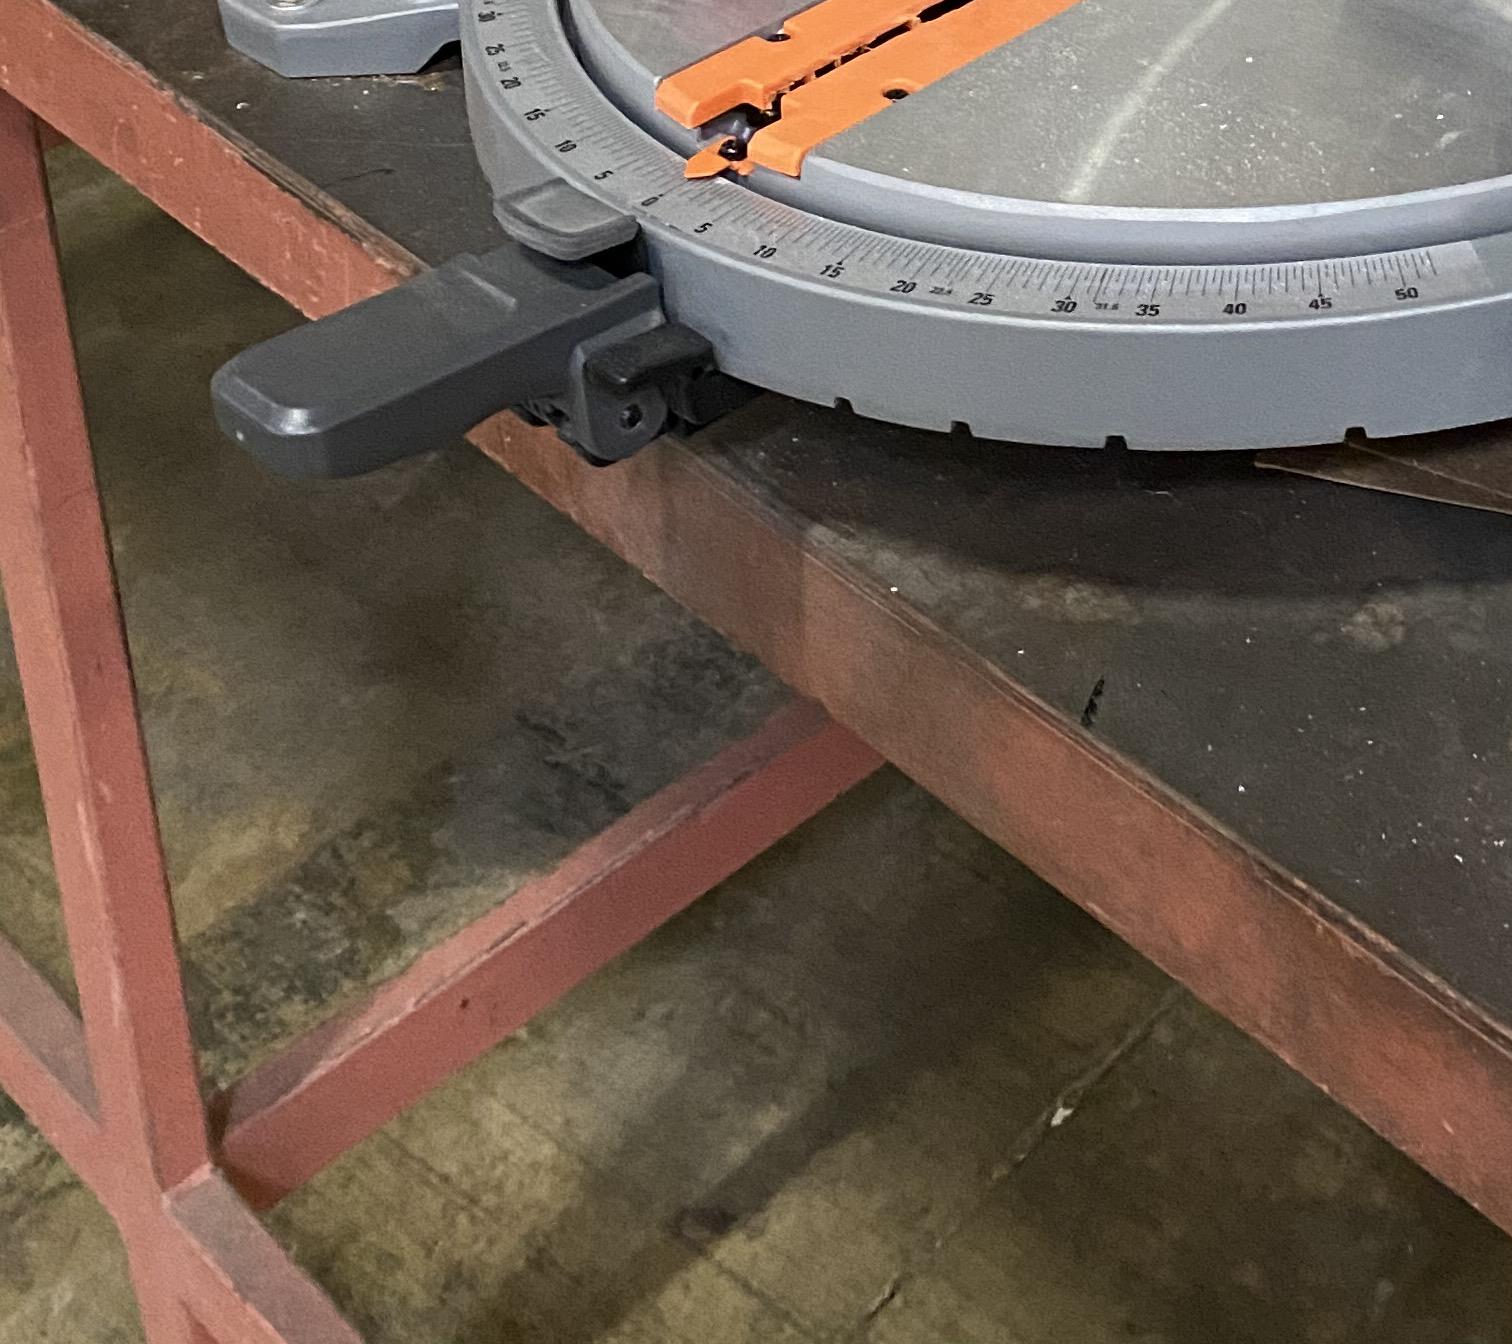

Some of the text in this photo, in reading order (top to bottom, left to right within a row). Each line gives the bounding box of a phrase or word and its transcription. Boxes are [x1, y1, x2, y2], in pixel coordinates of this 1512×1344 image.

[500, 76, 521, 90] 20
[524, 107, 546, 121] 15
[555, 139, 577, 153] 10
[594, 169, 614, 182] 5
[694, 221, 713, 235] 5
[753, 244, 777, 259] 10
[819, 264, 844, 279] 15
[889, 280, 917, 294] 20
[967, 292, 996, 305] 25
[1050, 300, 1078, 313] 30
[1135, 304, 1160, 317] 35
[1223, 302, 1248, 315] 40
[1308, 297, 1333, 310] 45
[1394, 287, 1419, 300] 50
